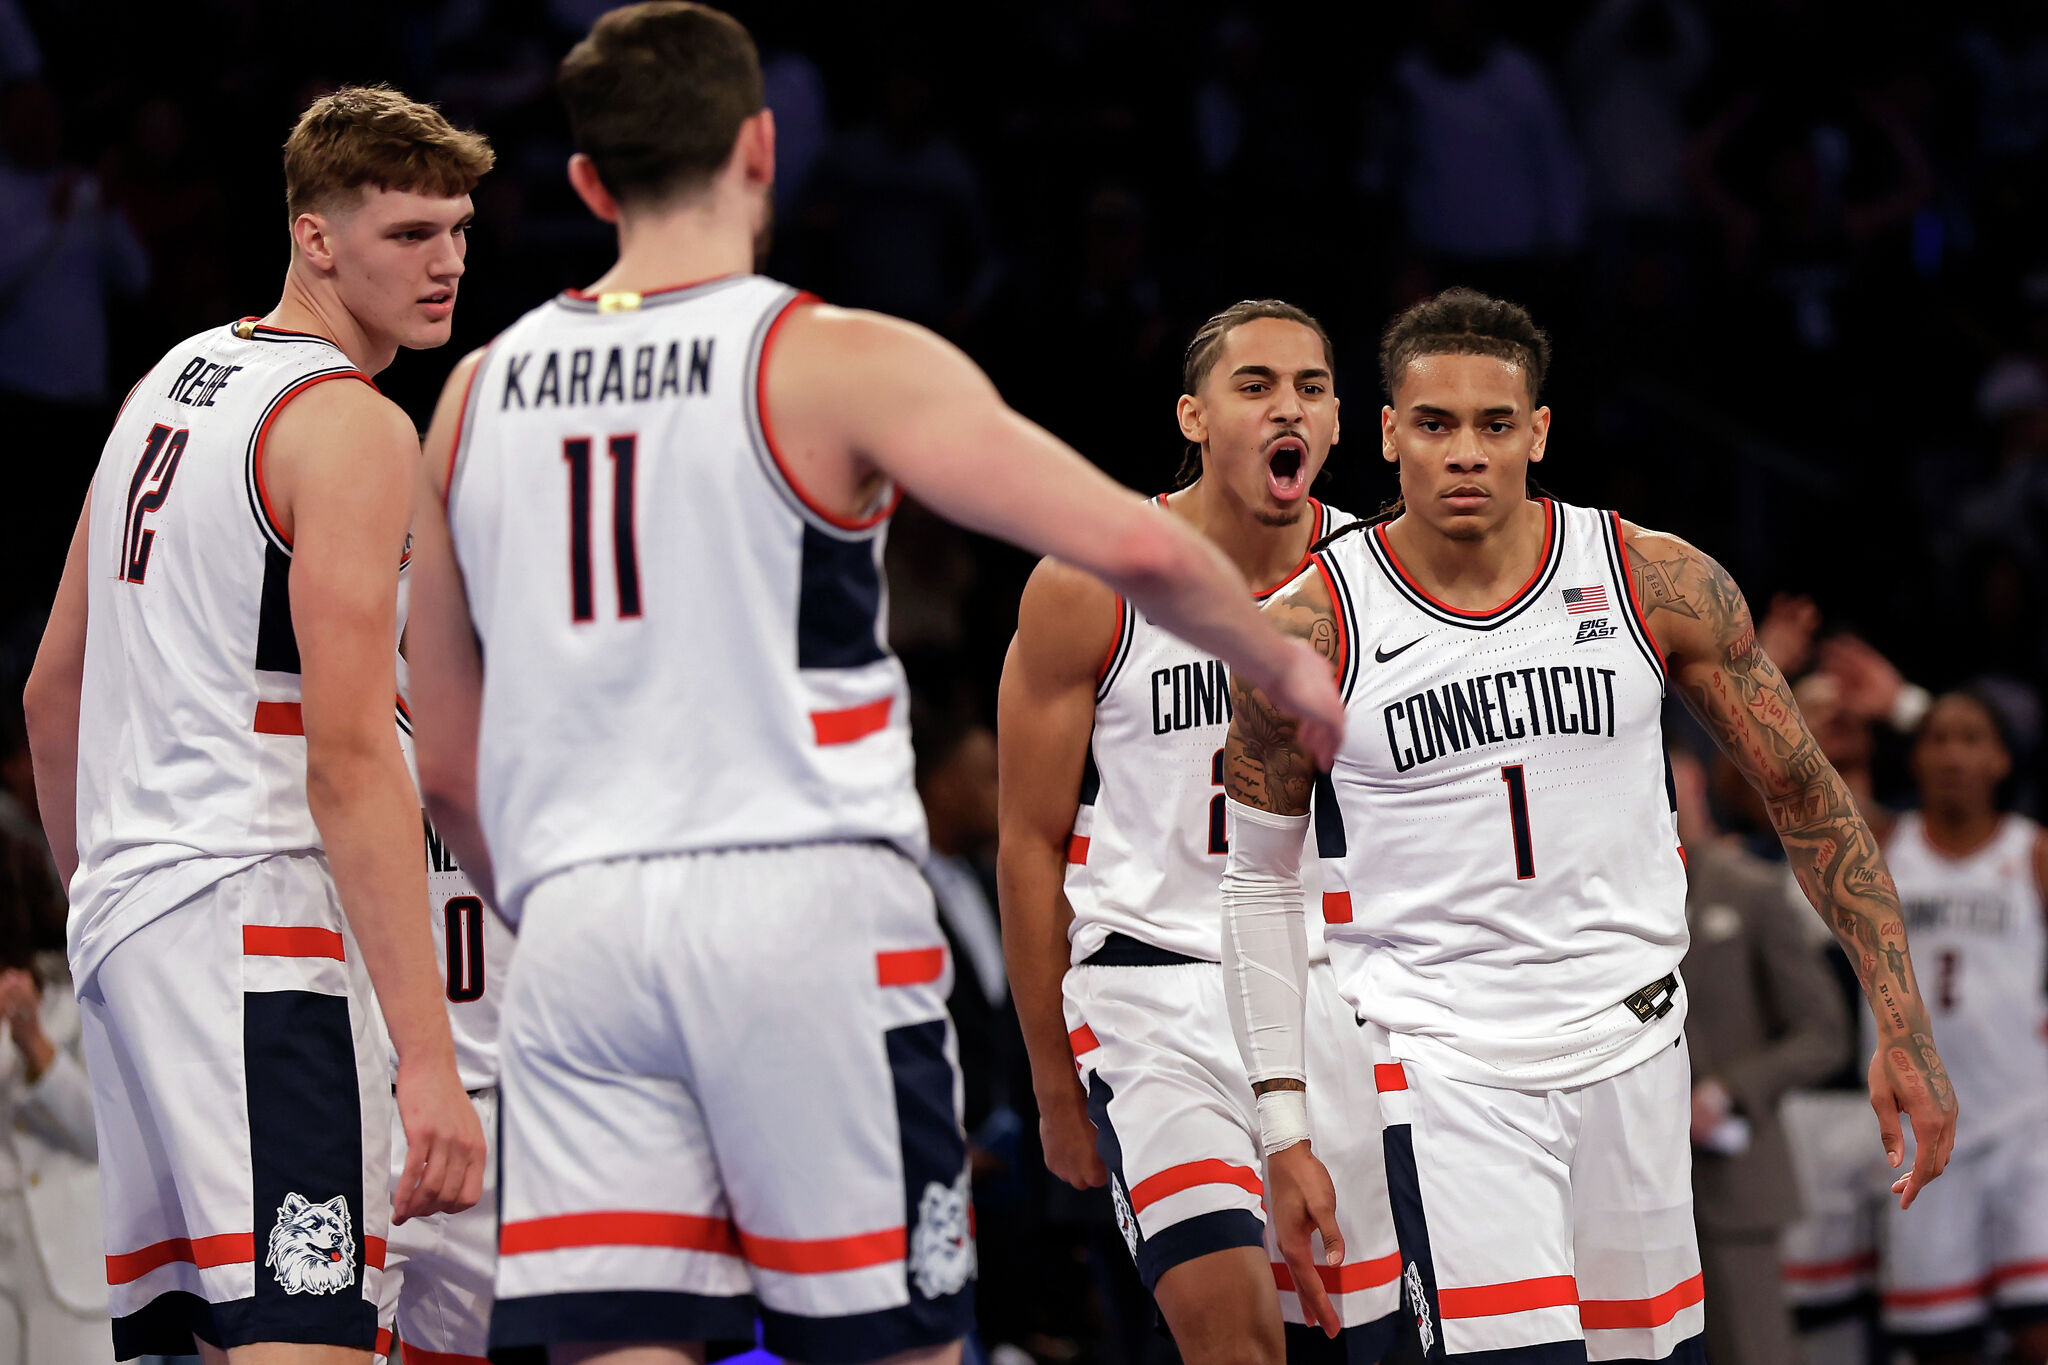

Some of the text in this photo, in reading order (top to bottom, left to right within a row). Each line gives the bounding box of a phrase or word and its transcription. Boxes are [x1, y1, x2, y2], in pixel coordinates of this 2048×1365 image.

[501, 337, 716, 412] KARABAN
[119, 422, 189, 585] 12
[562, 432, 643, 625] 11
[1576, 627, 1618, 639] EAST
[1579, 618, 1608, 631] BIG
[1384, 667, 1616, 773] CONNECTICUT
[1501, 764, 1536, 880] 1
[444, 896, 485, 1003] 0
